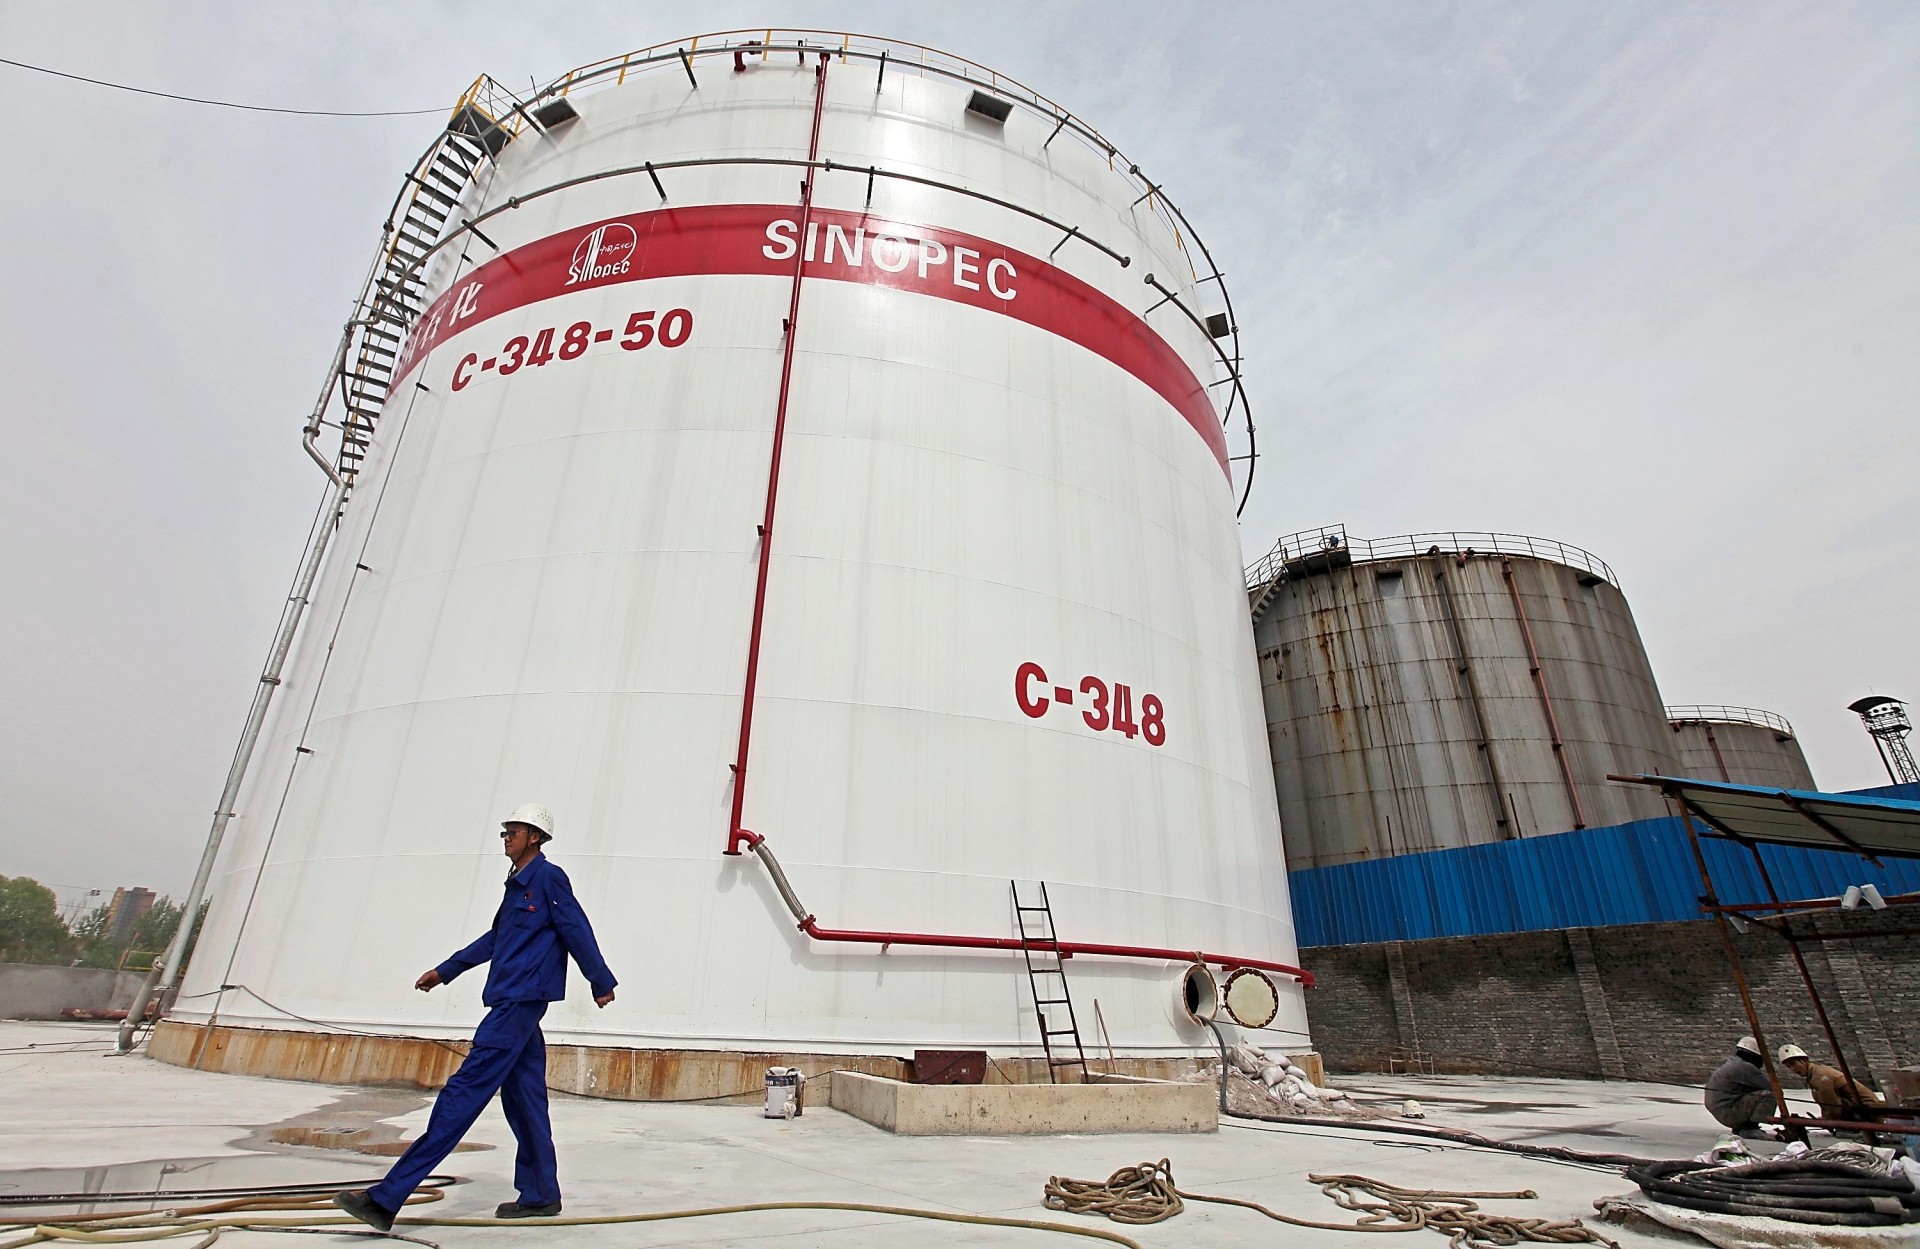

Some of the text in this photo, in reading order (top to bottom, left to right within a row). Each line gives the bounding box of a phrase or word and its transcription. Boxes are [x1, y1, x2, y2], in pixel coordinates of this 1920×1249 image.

[762, 219, 1017, 301] SINOPEC
[451, 308, 694, 392] C-348-50
[1015, 661, 1166, 747] C-348
